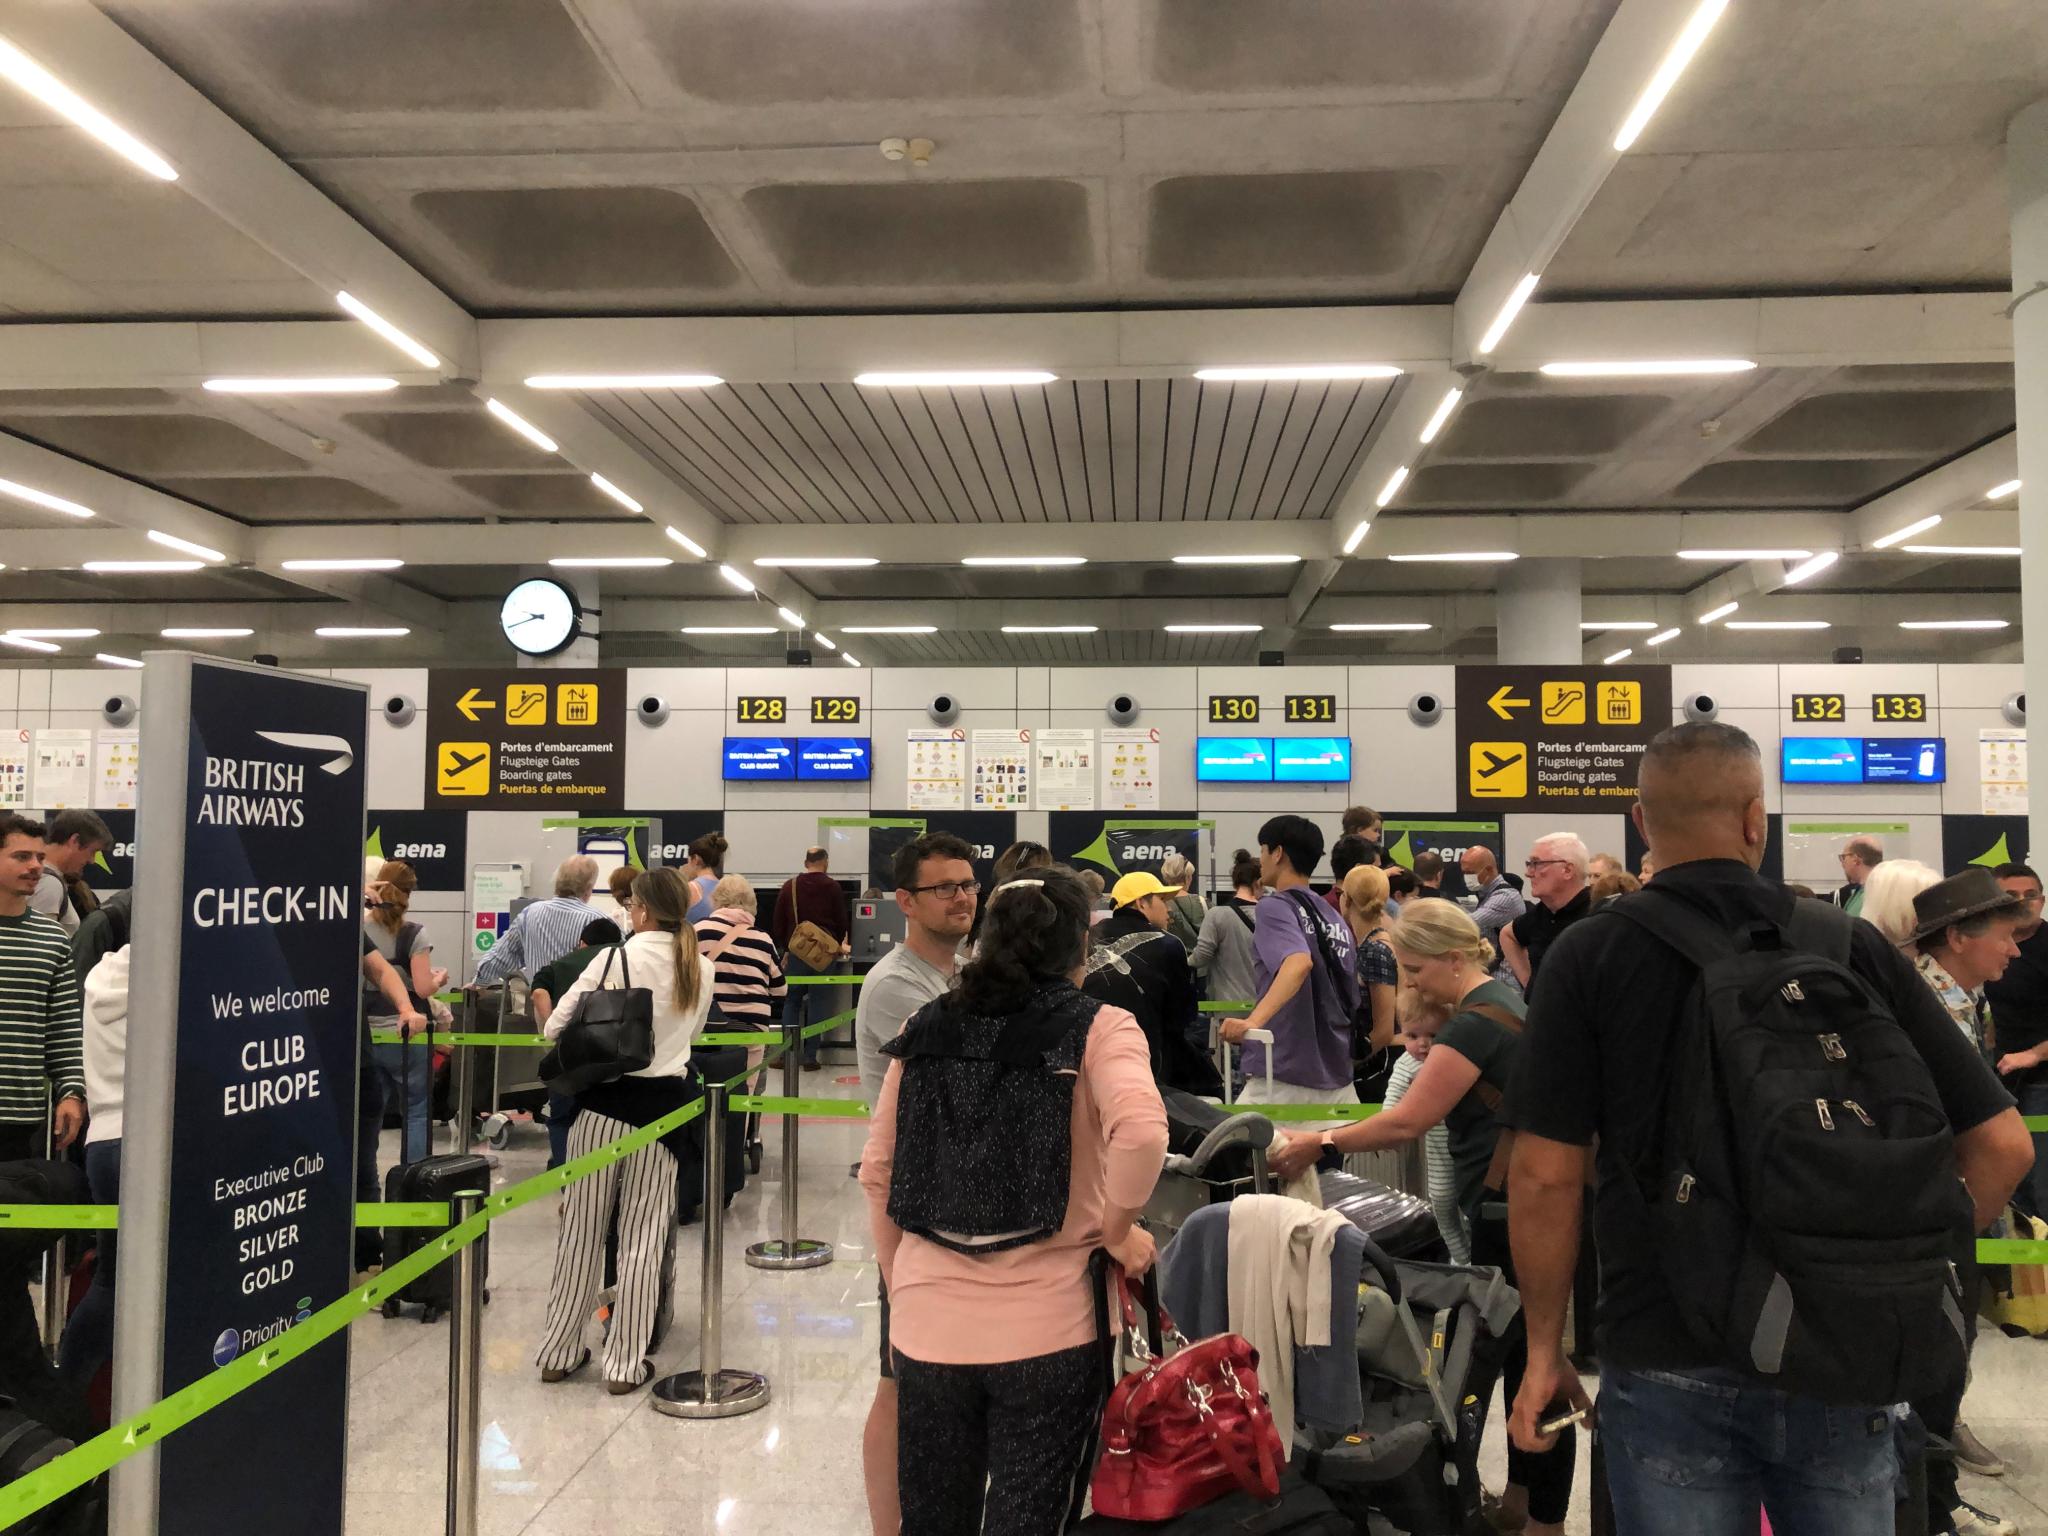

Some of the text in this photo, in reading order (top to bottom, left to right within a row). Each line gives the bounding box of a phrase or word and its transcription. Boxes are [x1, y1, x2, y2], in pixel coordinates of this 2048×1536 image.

[740, 699, 783, 720] 128
[813, 699, 857, 720] 129
[1212, 699, 1257, 720] 130
[1288, 698, 1332, 719] 131
[1795, 697, 1842, 719] 132
[1876, 697, 1923, 719] 133
[500, 741, 614, 752] Portes d'embarcament
[1537, 741, 1572, 753] Portes
[500, 755, 580, 768] Flugsteige Gates
[1538, 756, 1625, 769] Flugsteige Gates
[205, 757, 304, 793] BRITISH
[500, 769, 573, 782] Boarding gates
[1538, 770, 1617, 784] Boarding gates
[499, 783, 607, 795] Puertas de embarque
[1538, 785, 1580, 796] Puertas
[1582, 786, 1597, 796] de
[197, 795, 305, 828] AIRWAYS
[394, 843, 447, 858] aena
[650, 844, 690, 859] aen
[193, 885, 350, 927] CHECK-IN
[211, 986, 330, 1019] We welcome
[241, 1034, 306, 1072] CLUB
[223, 1069, 321, 1116] EUROPE
[214, 1152, 324, 1201] Executive Club
[234, 1188, 307, 1230] BRONZE
[238, 1224, 299, 1263] SILVER
[241, 1258, 294, 1295] GOLD
[242, 1315, 293, 1350] Priority
